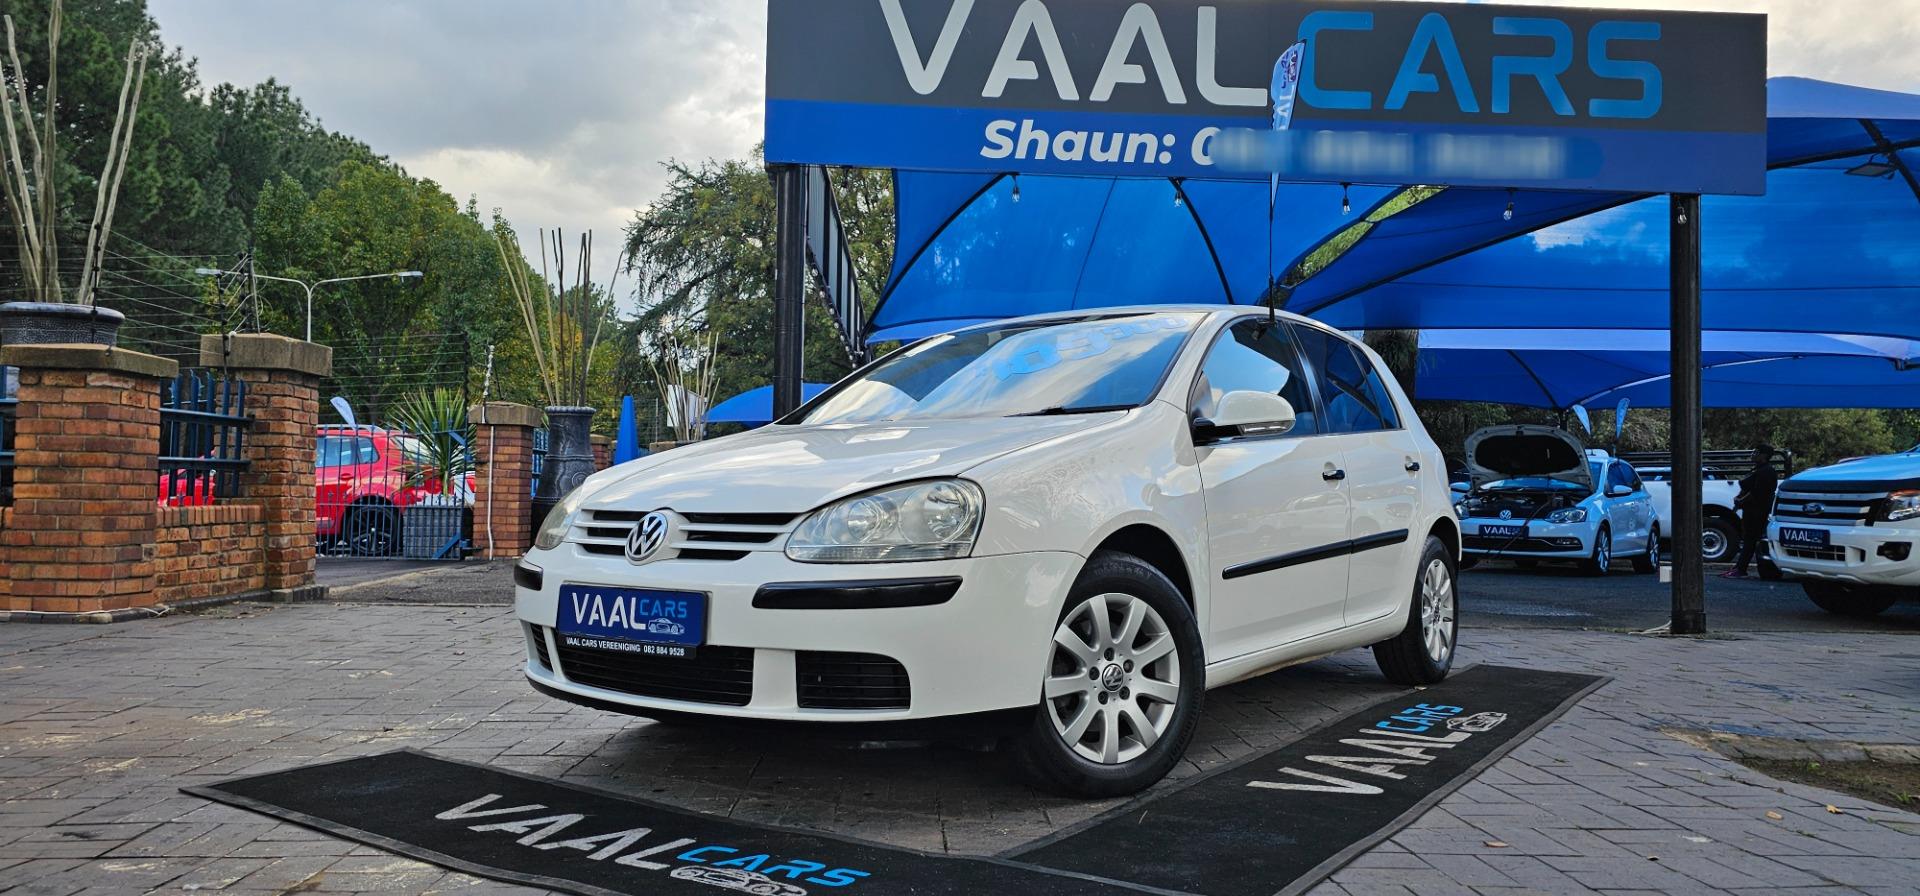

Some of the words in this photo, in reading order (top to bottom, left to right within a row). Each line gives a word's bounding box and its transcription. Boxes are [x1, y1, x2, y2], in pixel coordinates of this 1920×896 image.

[879, 0, 1268, 107] VAAL
[1297, 10, 1663, 119] CARS
[980, 119, 1176, 164] Shaun:
[1484, 526, 1511, 535] VAAL
[1783, 529, 1811, 541] VAAL
[572, 592, 646, 630] VAAL
[639, 599, 688, 618] CARS
[566, 636, 581, 646] VAAL
[582, 638, 598, 648] CARS
[598, 640, 640, 652] VEREENIGING
[643, 645, 655, 654] 082
[669, 647, 685, 657] 9528
[1246, 728, 1473, 795] VAAL
[1375, 703, 1464, 733] CARS
[435, 793, 697, 870] VAAL
[676, 845, 872, 887] CARS
